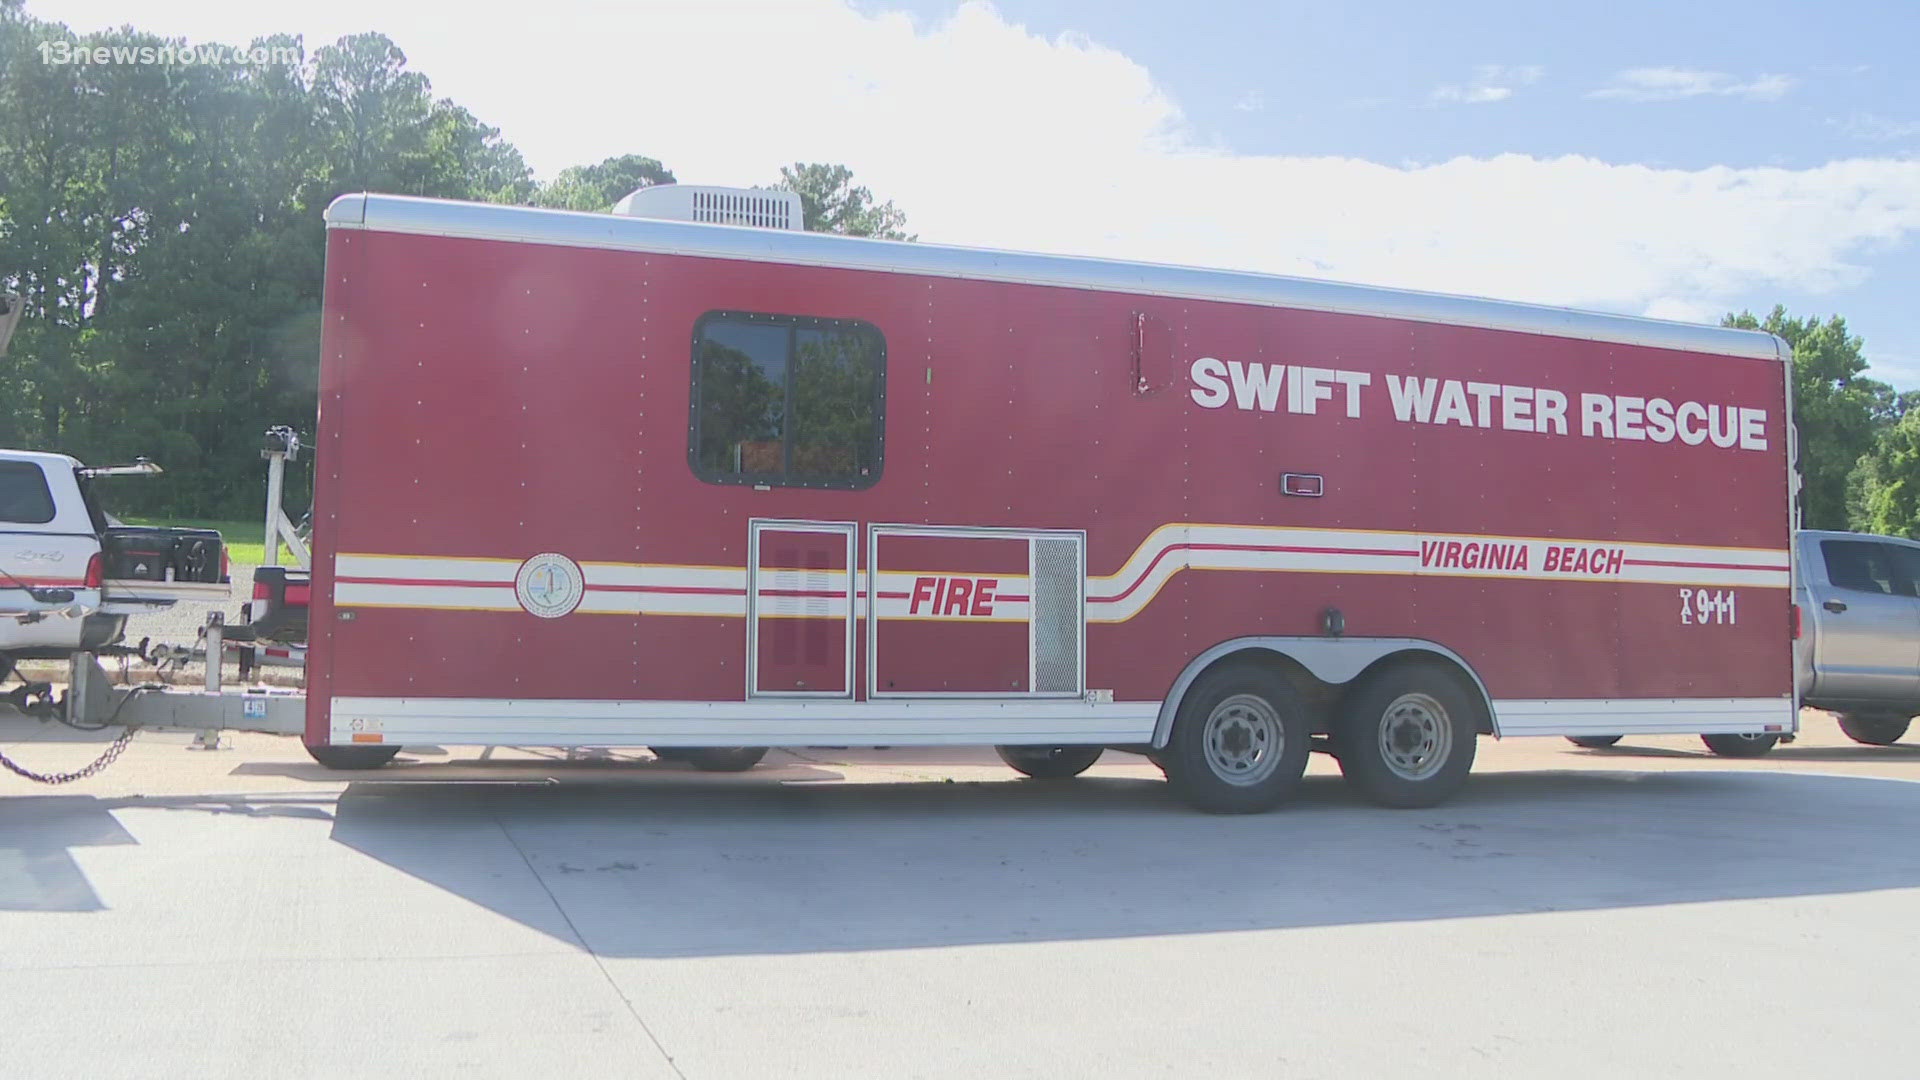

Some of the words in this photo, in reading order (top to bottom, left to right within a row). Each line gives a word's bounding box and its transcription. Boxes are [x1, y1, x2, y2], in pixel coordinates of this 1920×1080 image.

[1190, 357, 1371, 418] SWIFT
[1385, 374, 1568, 434] WATER
[1581, 393, 1768, 451] RESCUE
[1421, 541, 1528, 571] VIRGINIA
[1543, 546, 1624, 574] BEACH
[910, 577, 998, 616] FIRE
[1680, 588, 1692, 624] DIAL
